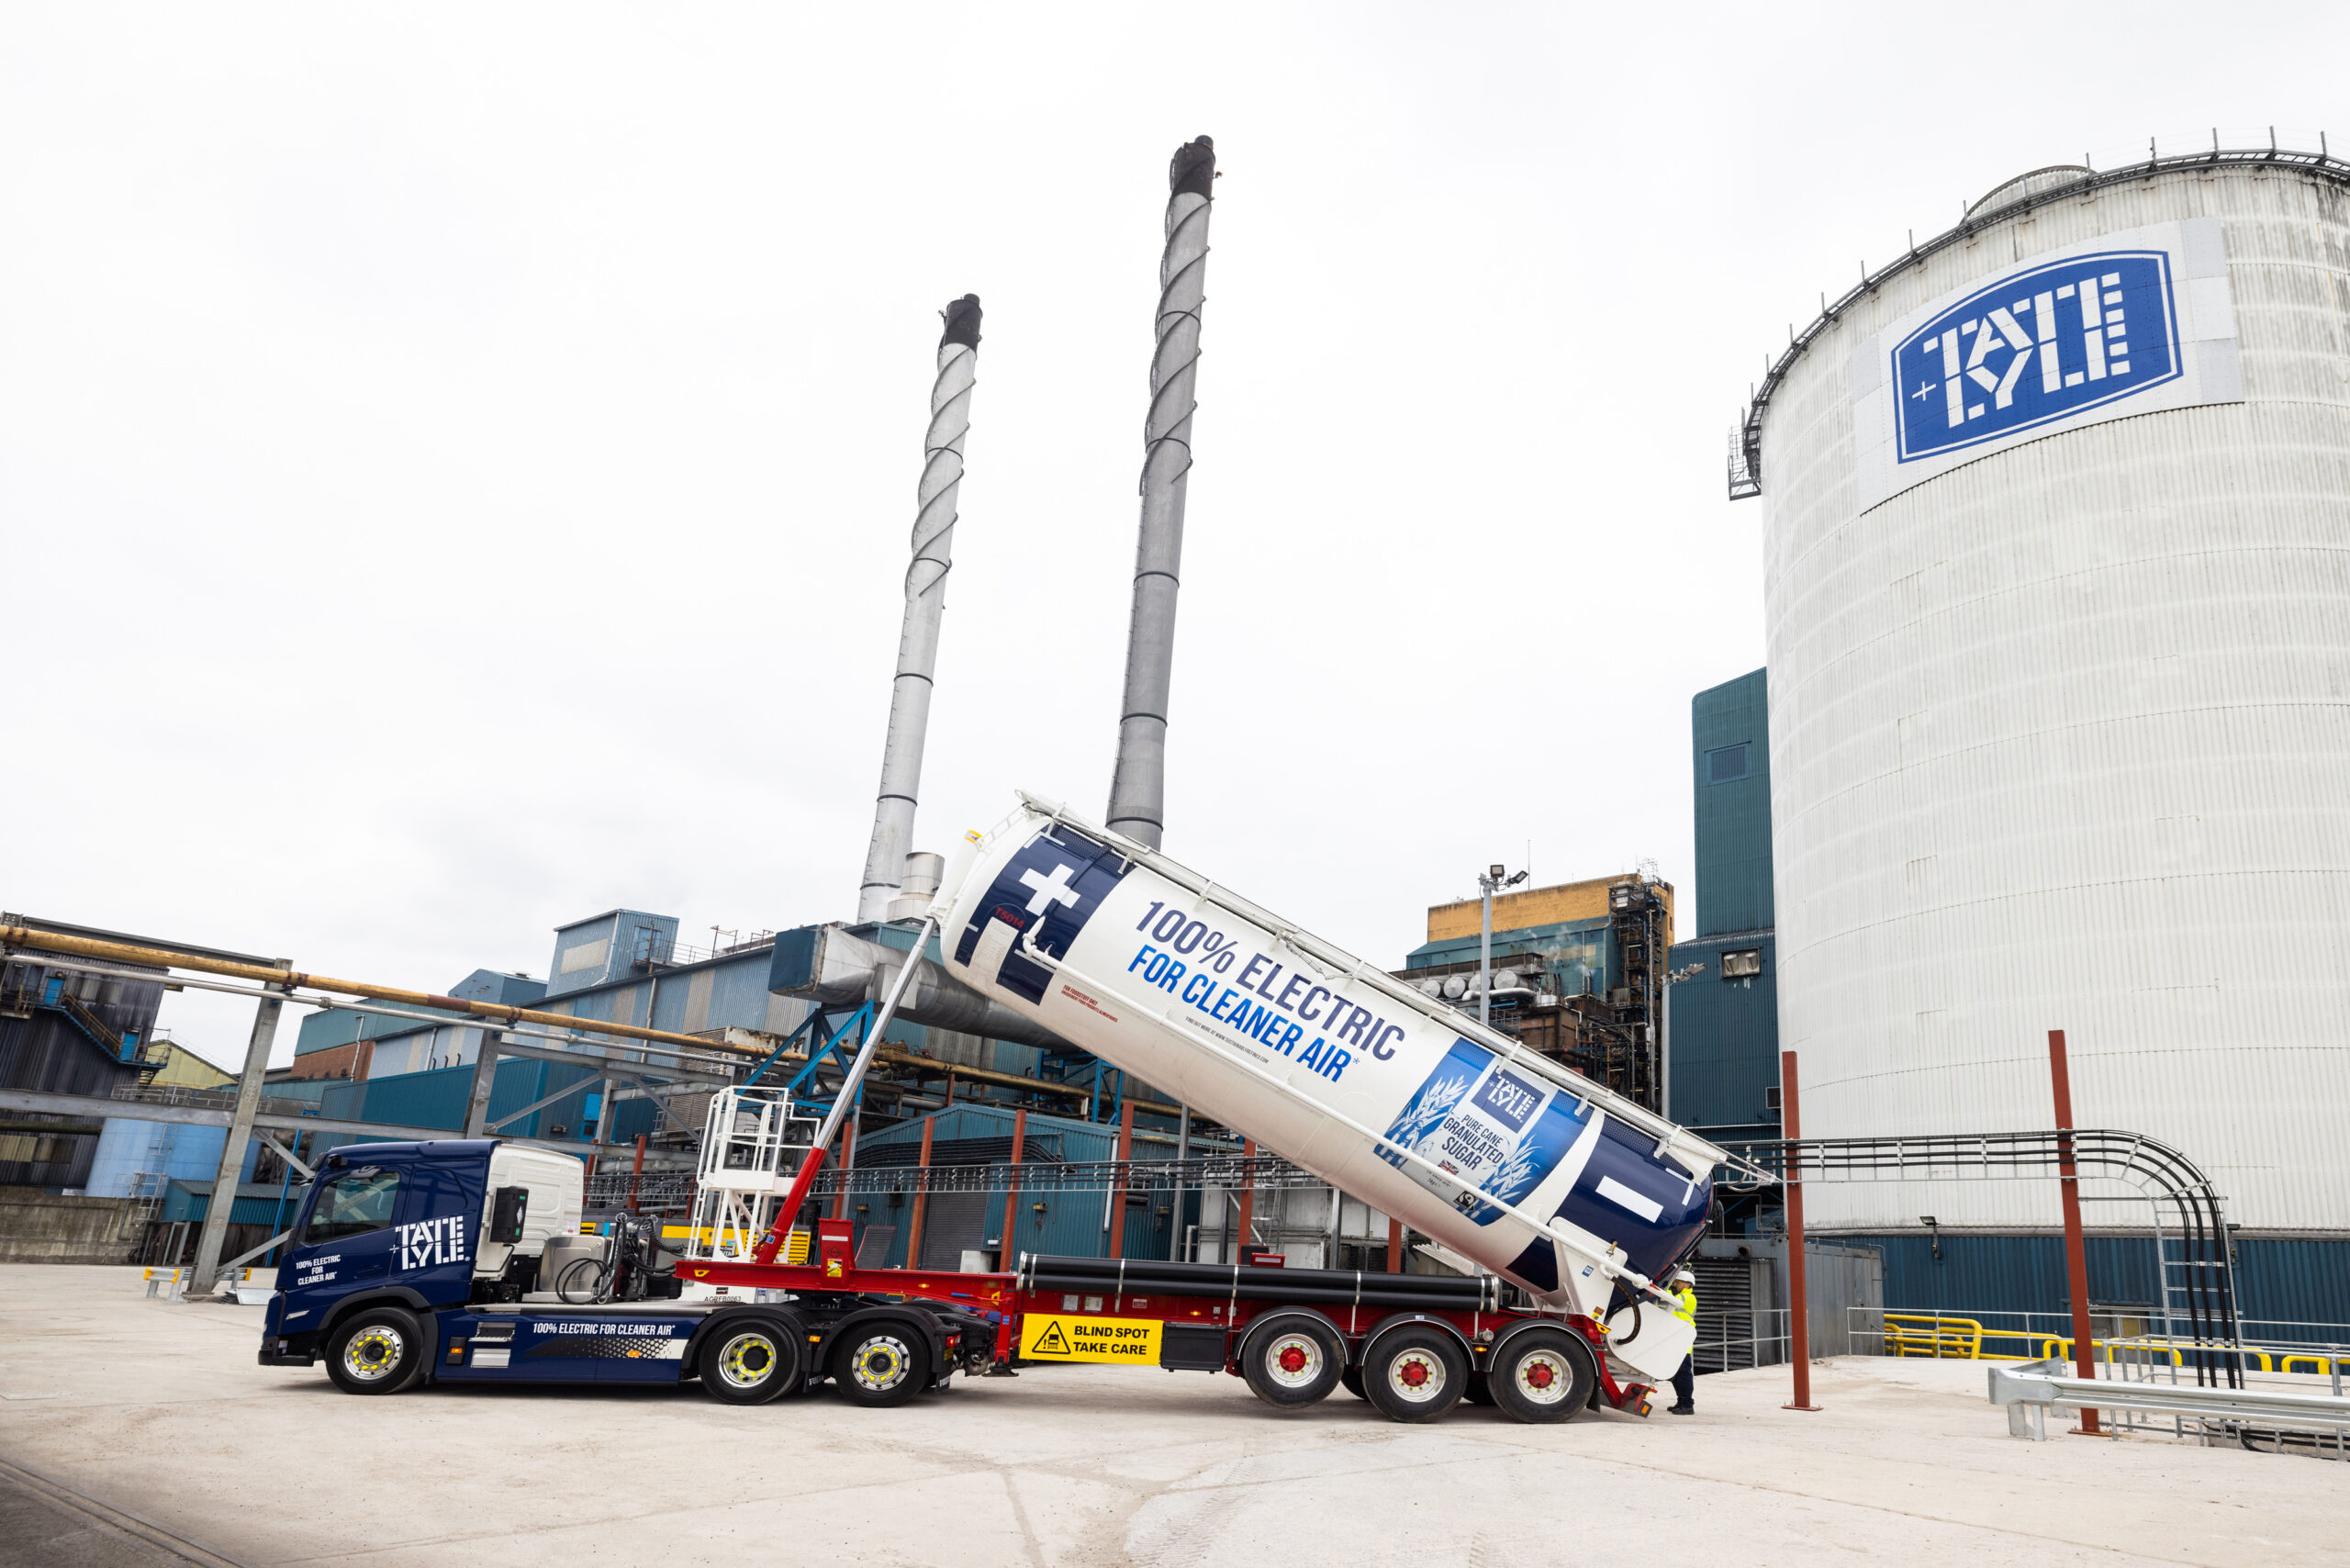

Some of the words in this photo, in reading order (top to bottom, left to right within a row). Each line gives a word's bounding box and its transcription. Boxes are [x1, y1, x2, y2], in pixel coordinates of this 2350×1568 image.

[1923, 272, 2124, 378] TATE
[1945, 323, 2131, 428] LYLE
[1136, 902, 1238, 973] 100%
[1236, 953, 1404, 1060] ELECTRIC
[1127, 944, 1186, 993] FOR
[1181, 974, 1303, 1057] CLEANER
[1487, 1088, 1528, 1120] LYLE
[1495, 1075, 1536, 1105] TATE
[1443, 1117, 1504, 1164] GRANULATED
[1461, 1114, 1483, 1133] PURE
[1481, 1127, 1503, 1148] CANE
[1441, 1137, 1483, 1170] SUGAR
[395, 1215, 464, 1247] TATE
[296, 1260, 312, 1270] 100%
[313, 1254, 341, 1266] ELECTRIC
[311, 1266, 323, 1274] FOR
[402, 1239, 464, 1271] LYLE
[297, 1274, 324, 1285] CLEANER
[532, 1323, 557, 1334] 100%
[559, 1323, 599, 1334] ELECTRIC
[599, 1324, 616, 1335] FOR
[618, 1324, 655, 1336] CLEANER
[1074, 1326, 1113, 1337] BLIND
[1115, 1327, 1150, 1339] SPOT
[1073, 1341, 1107, 1353] TAKE
[1111, 1343, 1147, 1355] CARE
